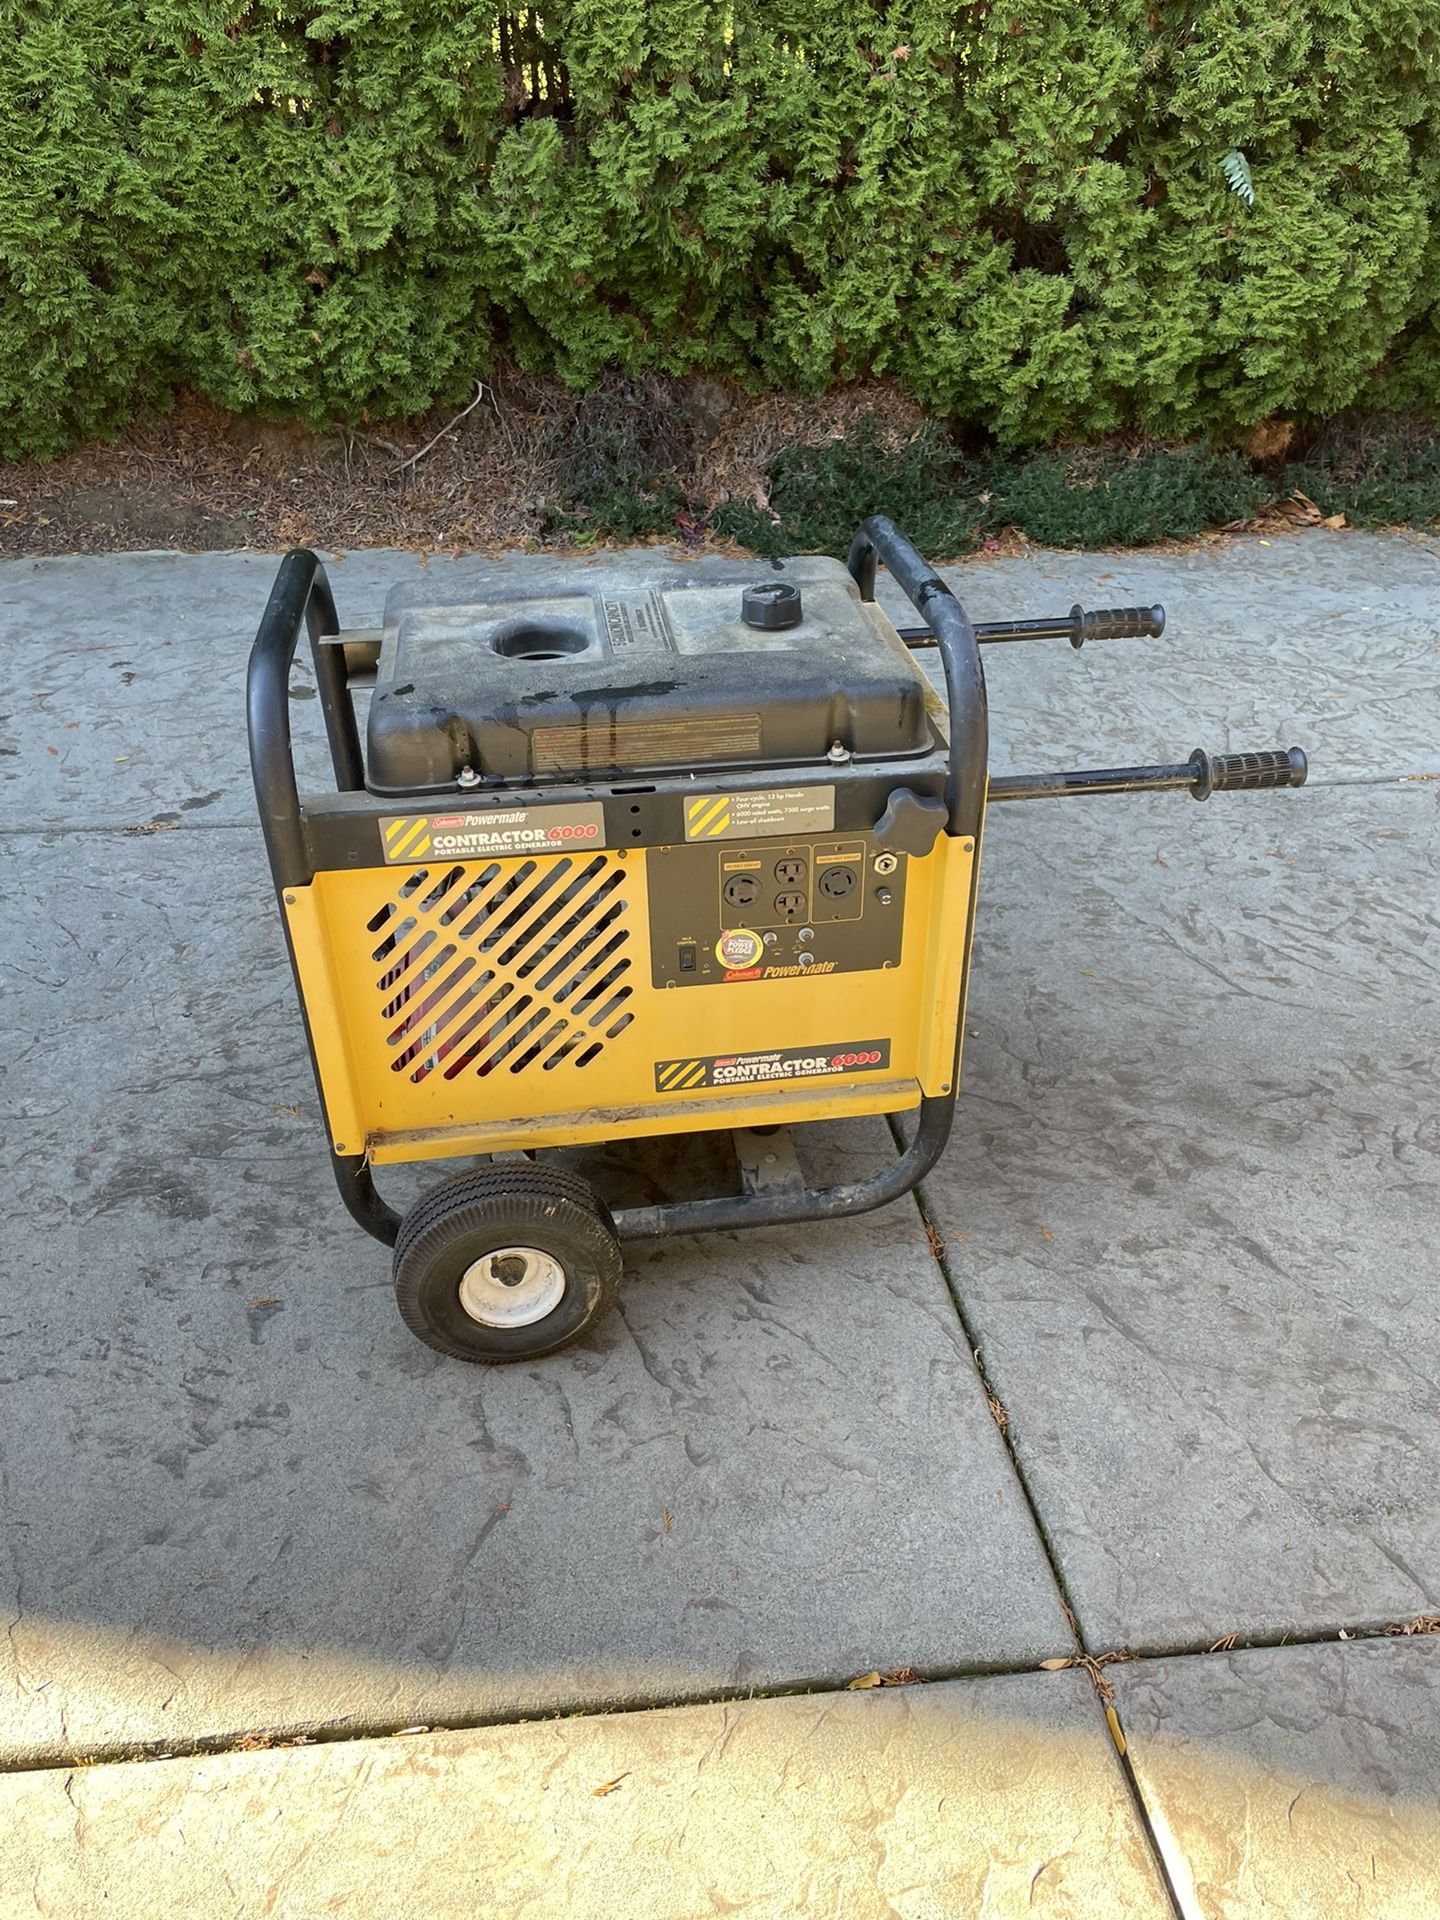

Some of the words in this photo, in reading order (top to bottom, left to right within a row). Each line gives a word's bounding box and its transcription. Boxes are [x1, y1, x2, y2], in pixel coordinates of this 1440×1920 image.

[464, 811, 527, 827] Powermate
[432, 828, 546, 849] CONTRACTOR
[547, 824, 598, 841] 6000
[434, 846, 475, 856] PORTABLE
[477, 843, 512, 852] ELECTRIC
[515, 840, 563, 850] GENERATOR
[727, 946, 752, 955] PLEDGE
[728, 940, 754, 949] POWER
[763, 961, 836, 978] Powermate
[712, 1056, 827, 1079] CONTRACTOR
[831, 1050, 882, 1067] 6000
[736, 1054, 782, 1065] Powermate
[713, 1075, 755, 1085] PORTABLE
[757, 1071, 793, 1080] ELECTRIC
[795, 1066, 844, 1076] GENERATOR
